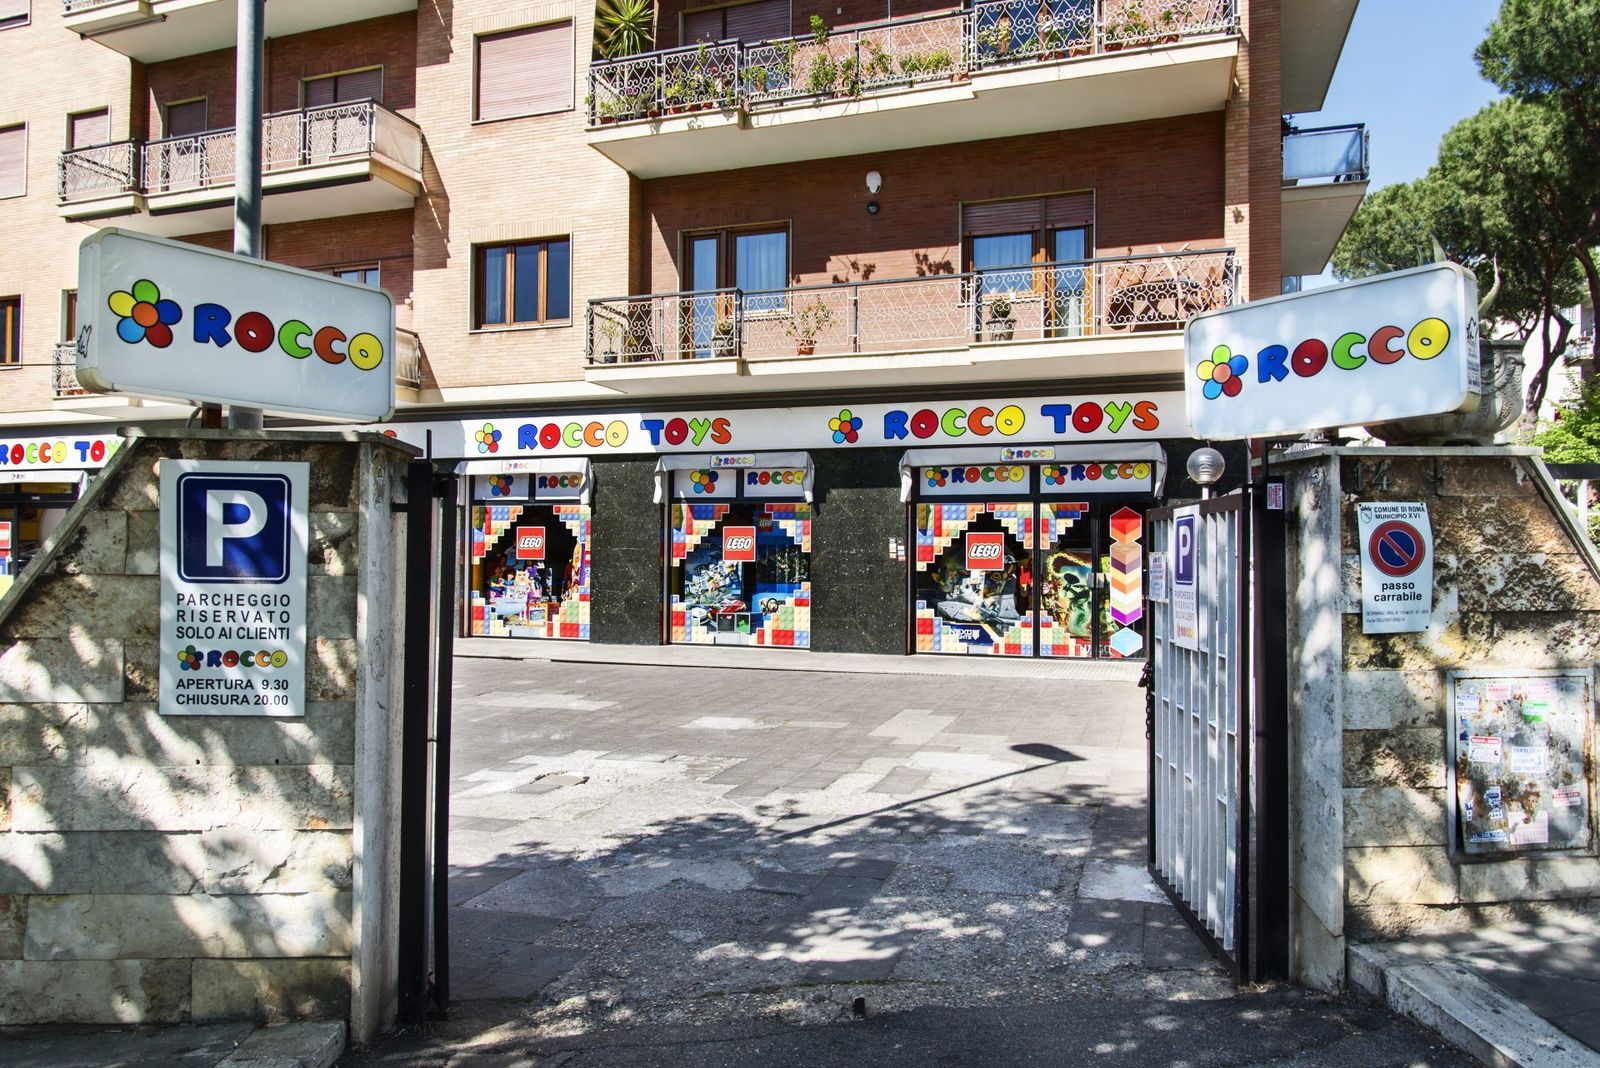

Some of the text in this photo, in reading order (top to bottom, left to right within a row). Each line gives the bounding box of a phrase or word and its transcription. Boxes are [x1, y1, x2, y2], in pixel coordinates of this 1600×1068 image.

[194, 303, 384, 371] ROCCO
[1257, 317, 1450, 384] ROCCO
[884, 400, 1160, 440] ROCCO TOYS
[518, 417, 732, 450] ROCCO TOYS
[74, 440, 119, 462] TOY
[1016, 449, 1055, 459] ROCCO
[723, 457, 754, 465] ROCCO
[951, 465, 1024, 483] ROCCO
[1071, 462, 1150, 481] ROCCO
[206, 489, 268, 567] P
[519, 536, 543, 548] LEGO
[725, 536, 753, 551] LEGO
[1178, 524, 1191, 574] P
[969, 544, 1002, 558] LEGO
[1382, 582, 1415, 592] passo
[177, 594, 290, 607] PARCHEGGIO
[1374, 592, 1422, 602] carrabile
[177, 610, 290, 623] RISERVATO
[176, 627, 290, 640] SOLO AI CLIENTI
[207, 650, 288, 668] ROCCO
[176, 679, 288, 690] APERTURA 9.30
[176, 694, 288, 705] CHIUSURA 20.00
